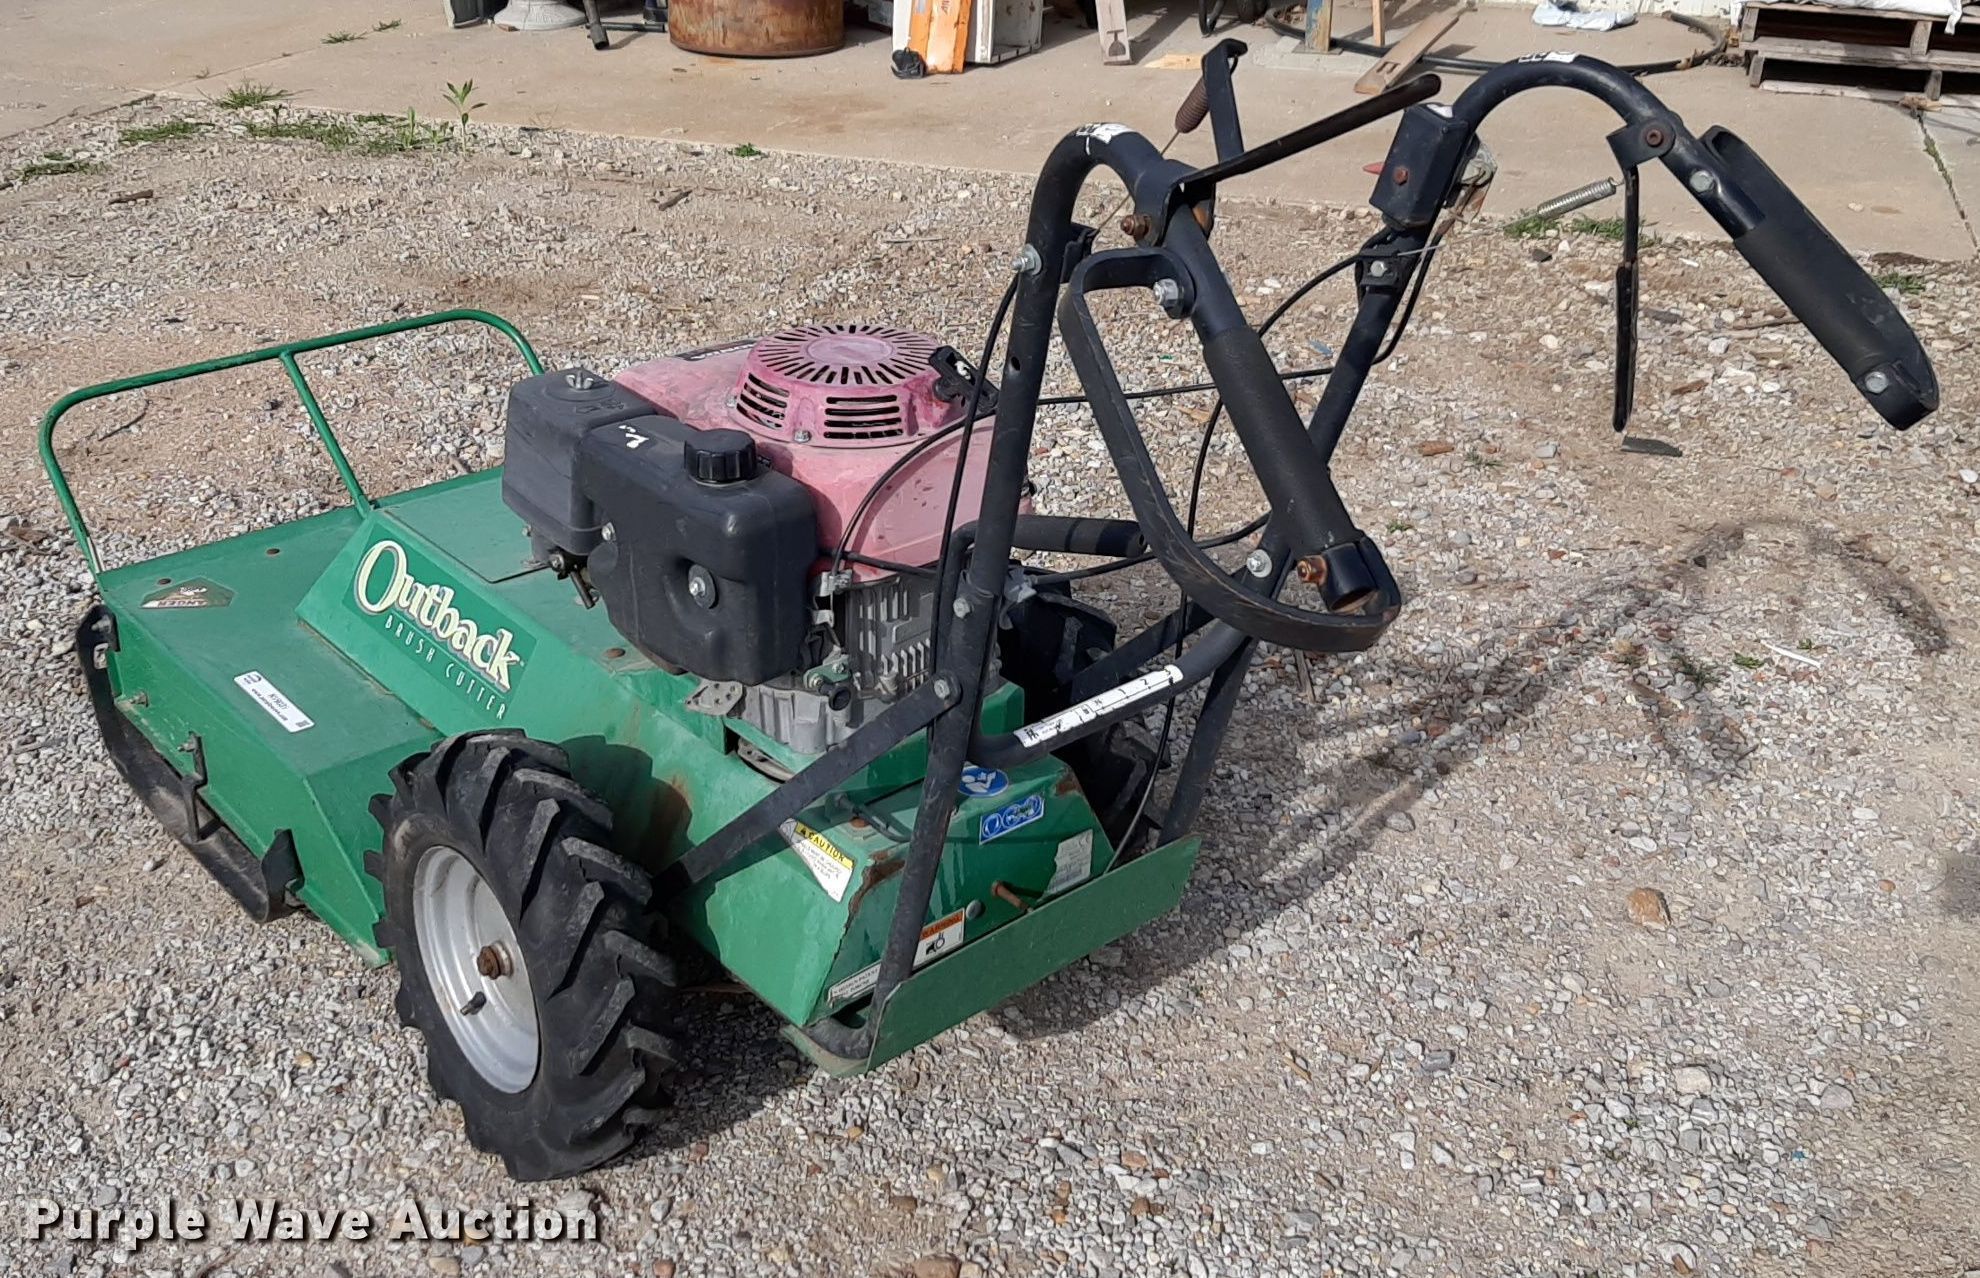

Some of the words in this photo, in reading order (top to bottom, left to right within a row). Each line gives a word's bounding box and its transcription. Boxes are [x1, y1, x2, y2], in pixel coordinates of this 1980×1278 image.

[354, 539, 520, 693] Outback
[385, 614, 436, 663] BRUSH
[445, 663, 506, 720] CUTTER
[808, 831, 845, 862] CAUTION
